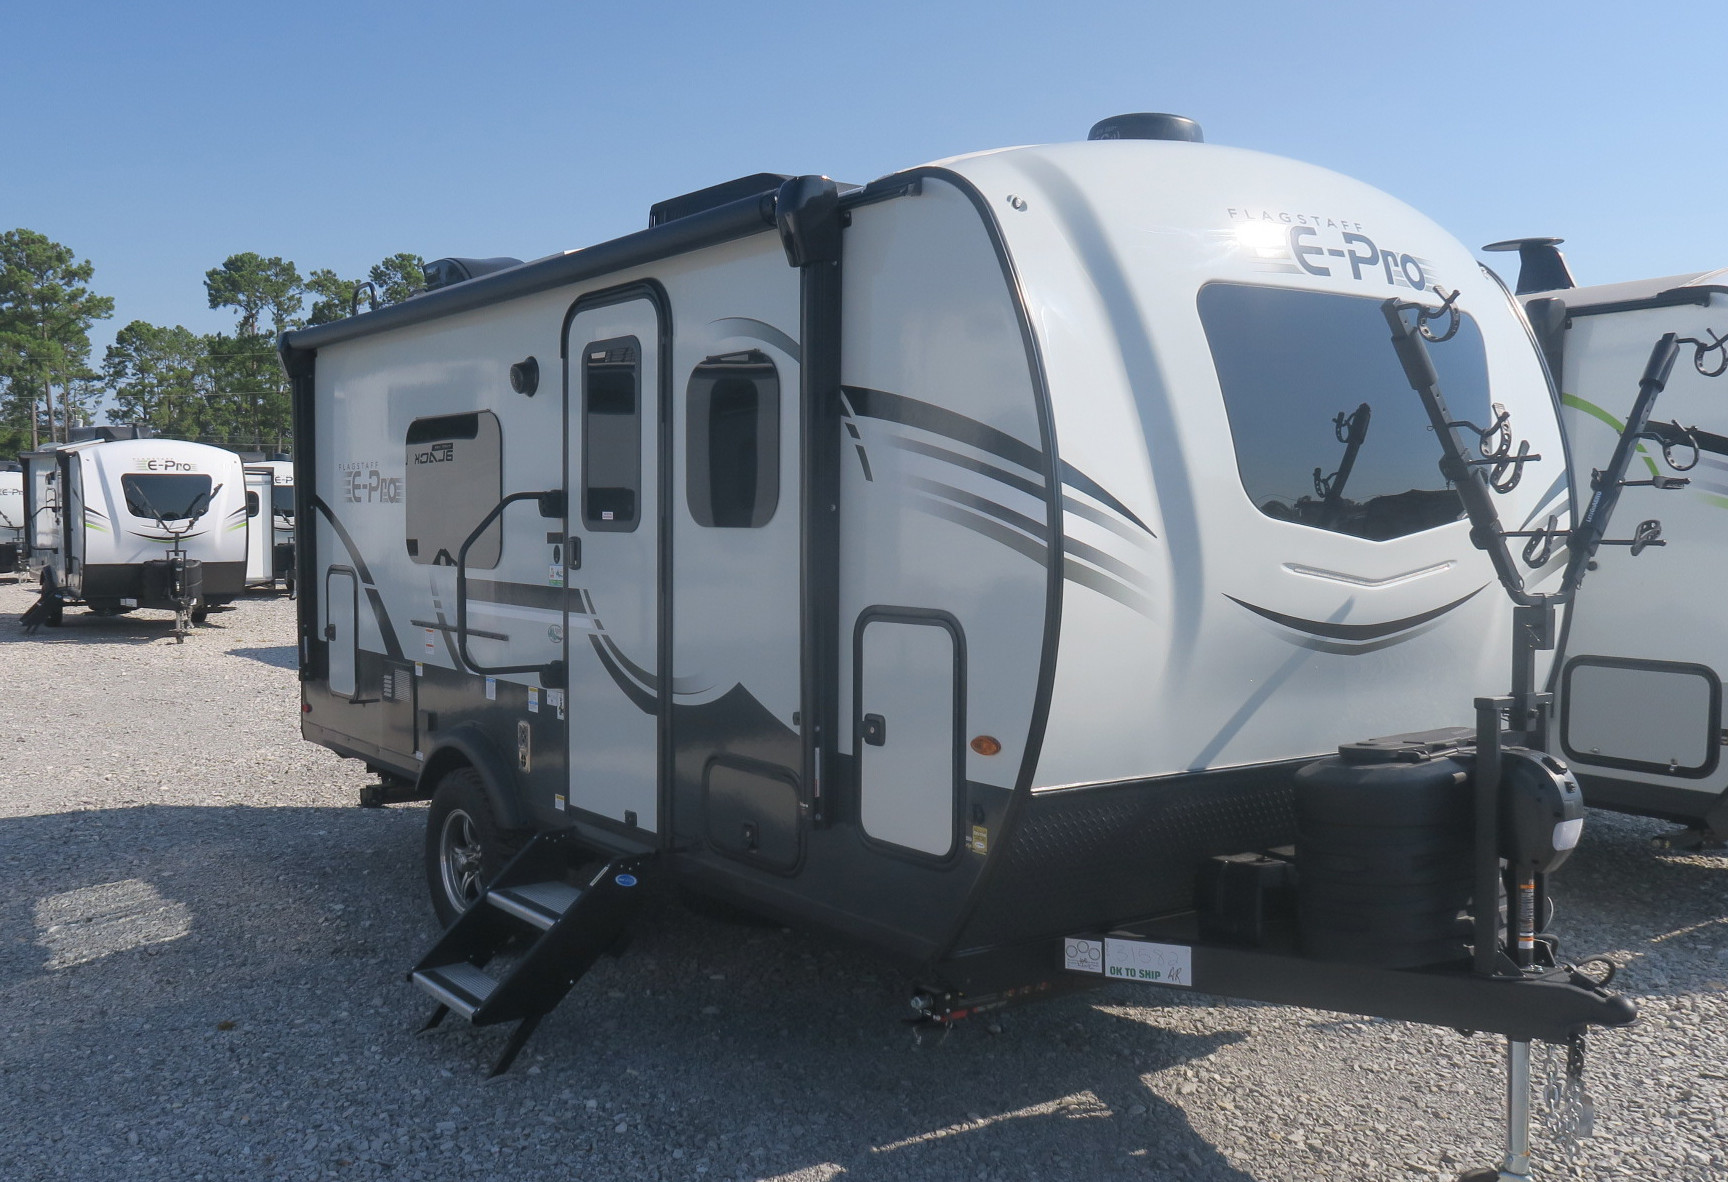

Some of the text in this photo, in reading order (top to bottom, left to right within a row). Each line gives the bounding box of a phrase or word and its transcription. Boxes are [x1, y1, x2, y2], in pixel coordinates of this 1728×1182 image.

[1227, 207, 1363, 233] FLAGSTAFF
[1289, 224, 1426, 291] E-Pro
[147, 460, 191, 471] E-Pro
[338, 461, 379, 471] FLAGSTAFF
[274, 476, 294, 484] E-P
[351, 469, 397, 504] E-Pro
[2, 488, 24, 496] E-Pr
[1109, 965, 1161, 980] OK TO SHIP
